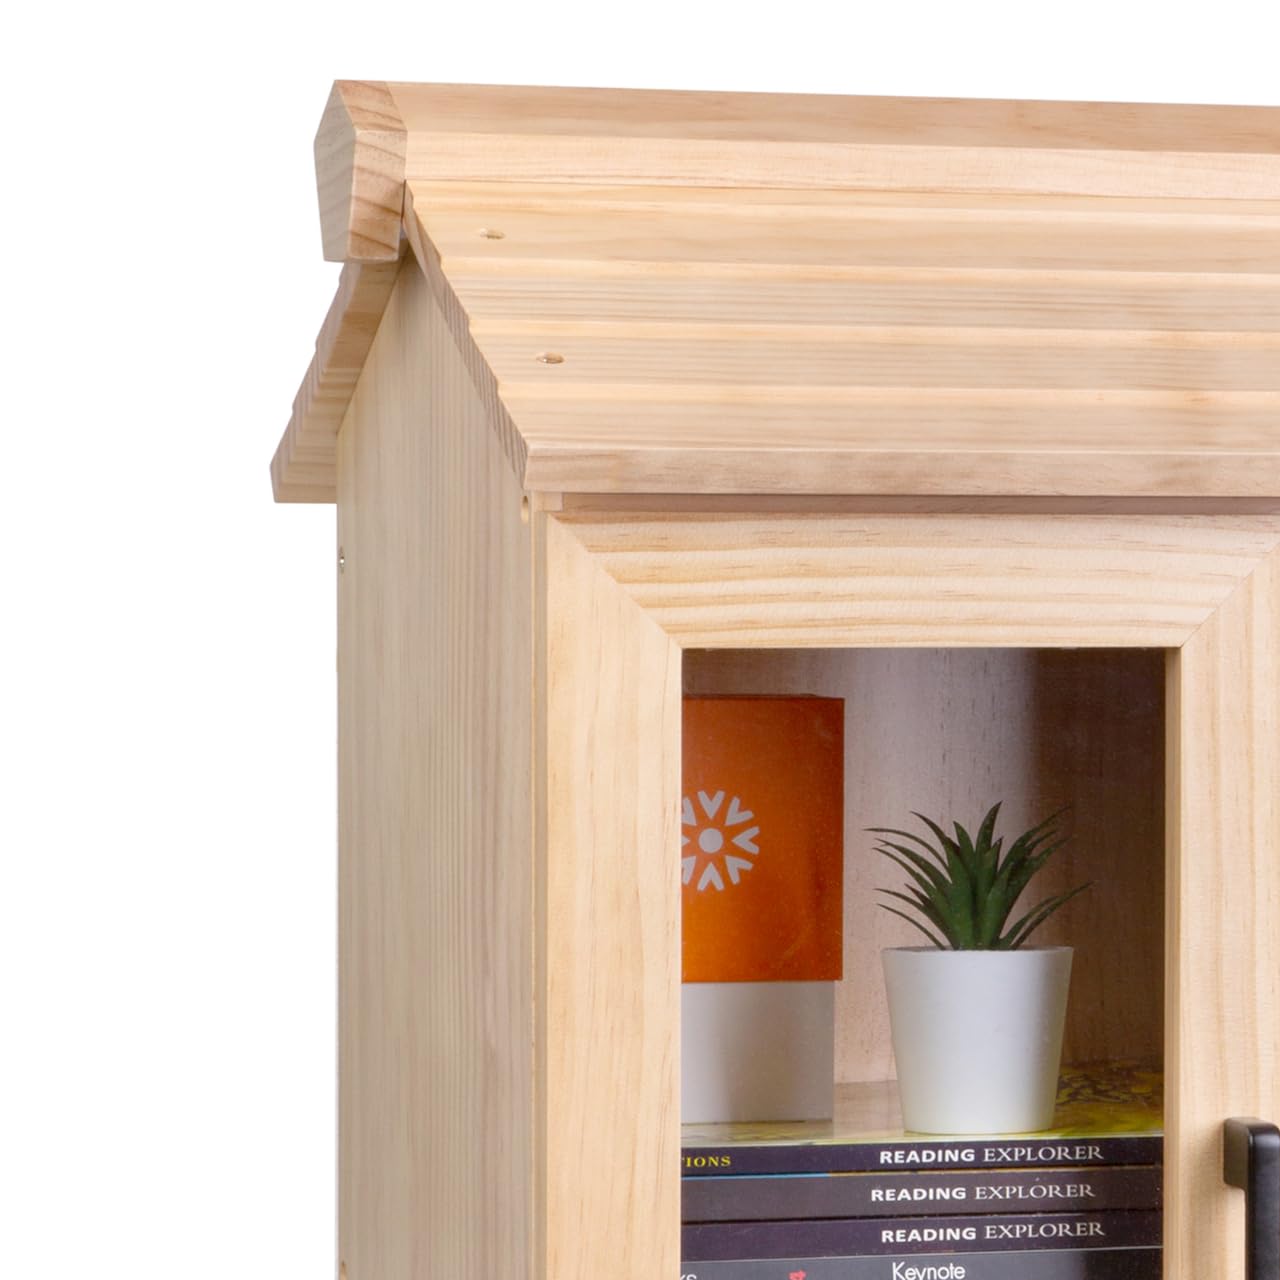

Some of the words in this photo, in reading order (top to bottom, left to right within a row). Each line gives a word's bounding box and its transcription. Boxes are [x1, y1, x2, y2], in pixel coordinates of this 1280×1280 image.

[681, 1156, 732, 1169] IONS
[880, 1149, 975, 1164] READING
[983, 1146, 1104, 1162] EXPLORER
[871, 1187, 967, 1202] READING
[975, 1184, 1096, 1200] EXPLORER
[881, 1227, 977, 1243] READING
[984, 1222, 1105, 1239] EXPLORER
